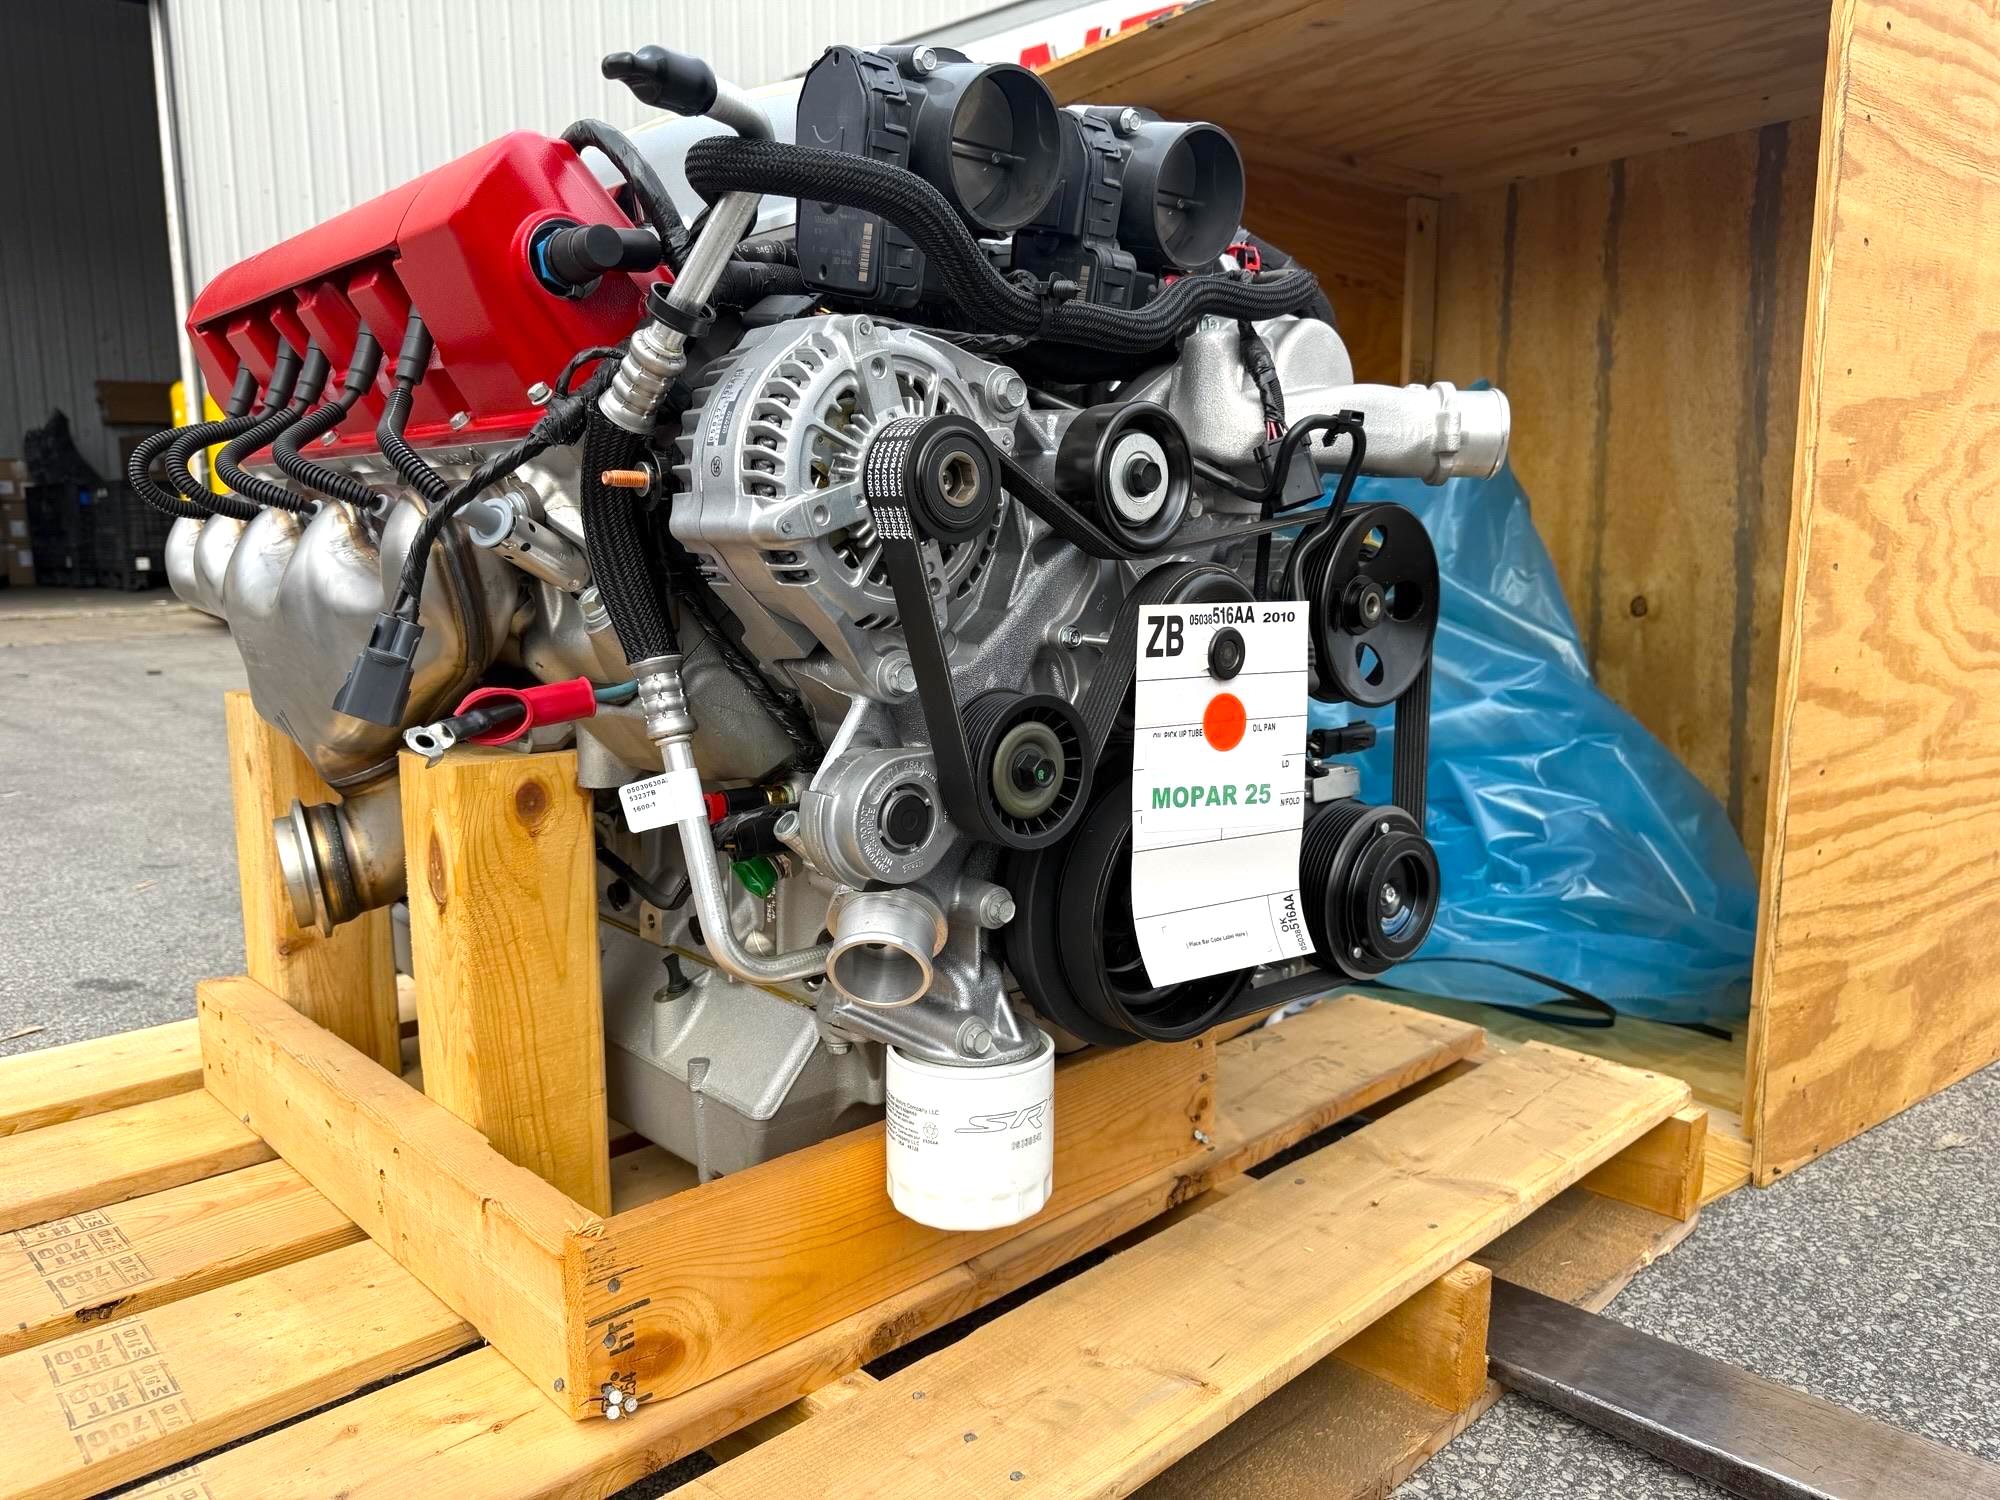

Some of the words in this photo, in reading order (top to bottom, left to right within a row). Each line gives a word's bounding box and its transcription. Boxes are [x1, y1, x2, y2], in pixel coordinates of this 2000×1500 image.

[867, 441, 880, 497] 05037862AD
[874, 441, 888, 497] 05037862AD
[882, 440, 895, 497] 05037862AD
[889, 440, 903, 497] 05037862AD
[1190, 605, 1255, 625] 05038516AA
[1263, 612, 1295, 623] 2010
[1146, 615, 1184, 658] ZB
[1179, 729, 1187, 737] UP
[1188, 728, 1203, 738] TUBE
[1252, 724, 1262, 732] OIL
[1264, 723, 1276, 731] PAN
[1152, 784, 1237, 809] MOPAR
[1245, 783, 1271, 805] 25
[1279, 917, 1289, 932] OK
[1210, 935, 1222, 943] Code
